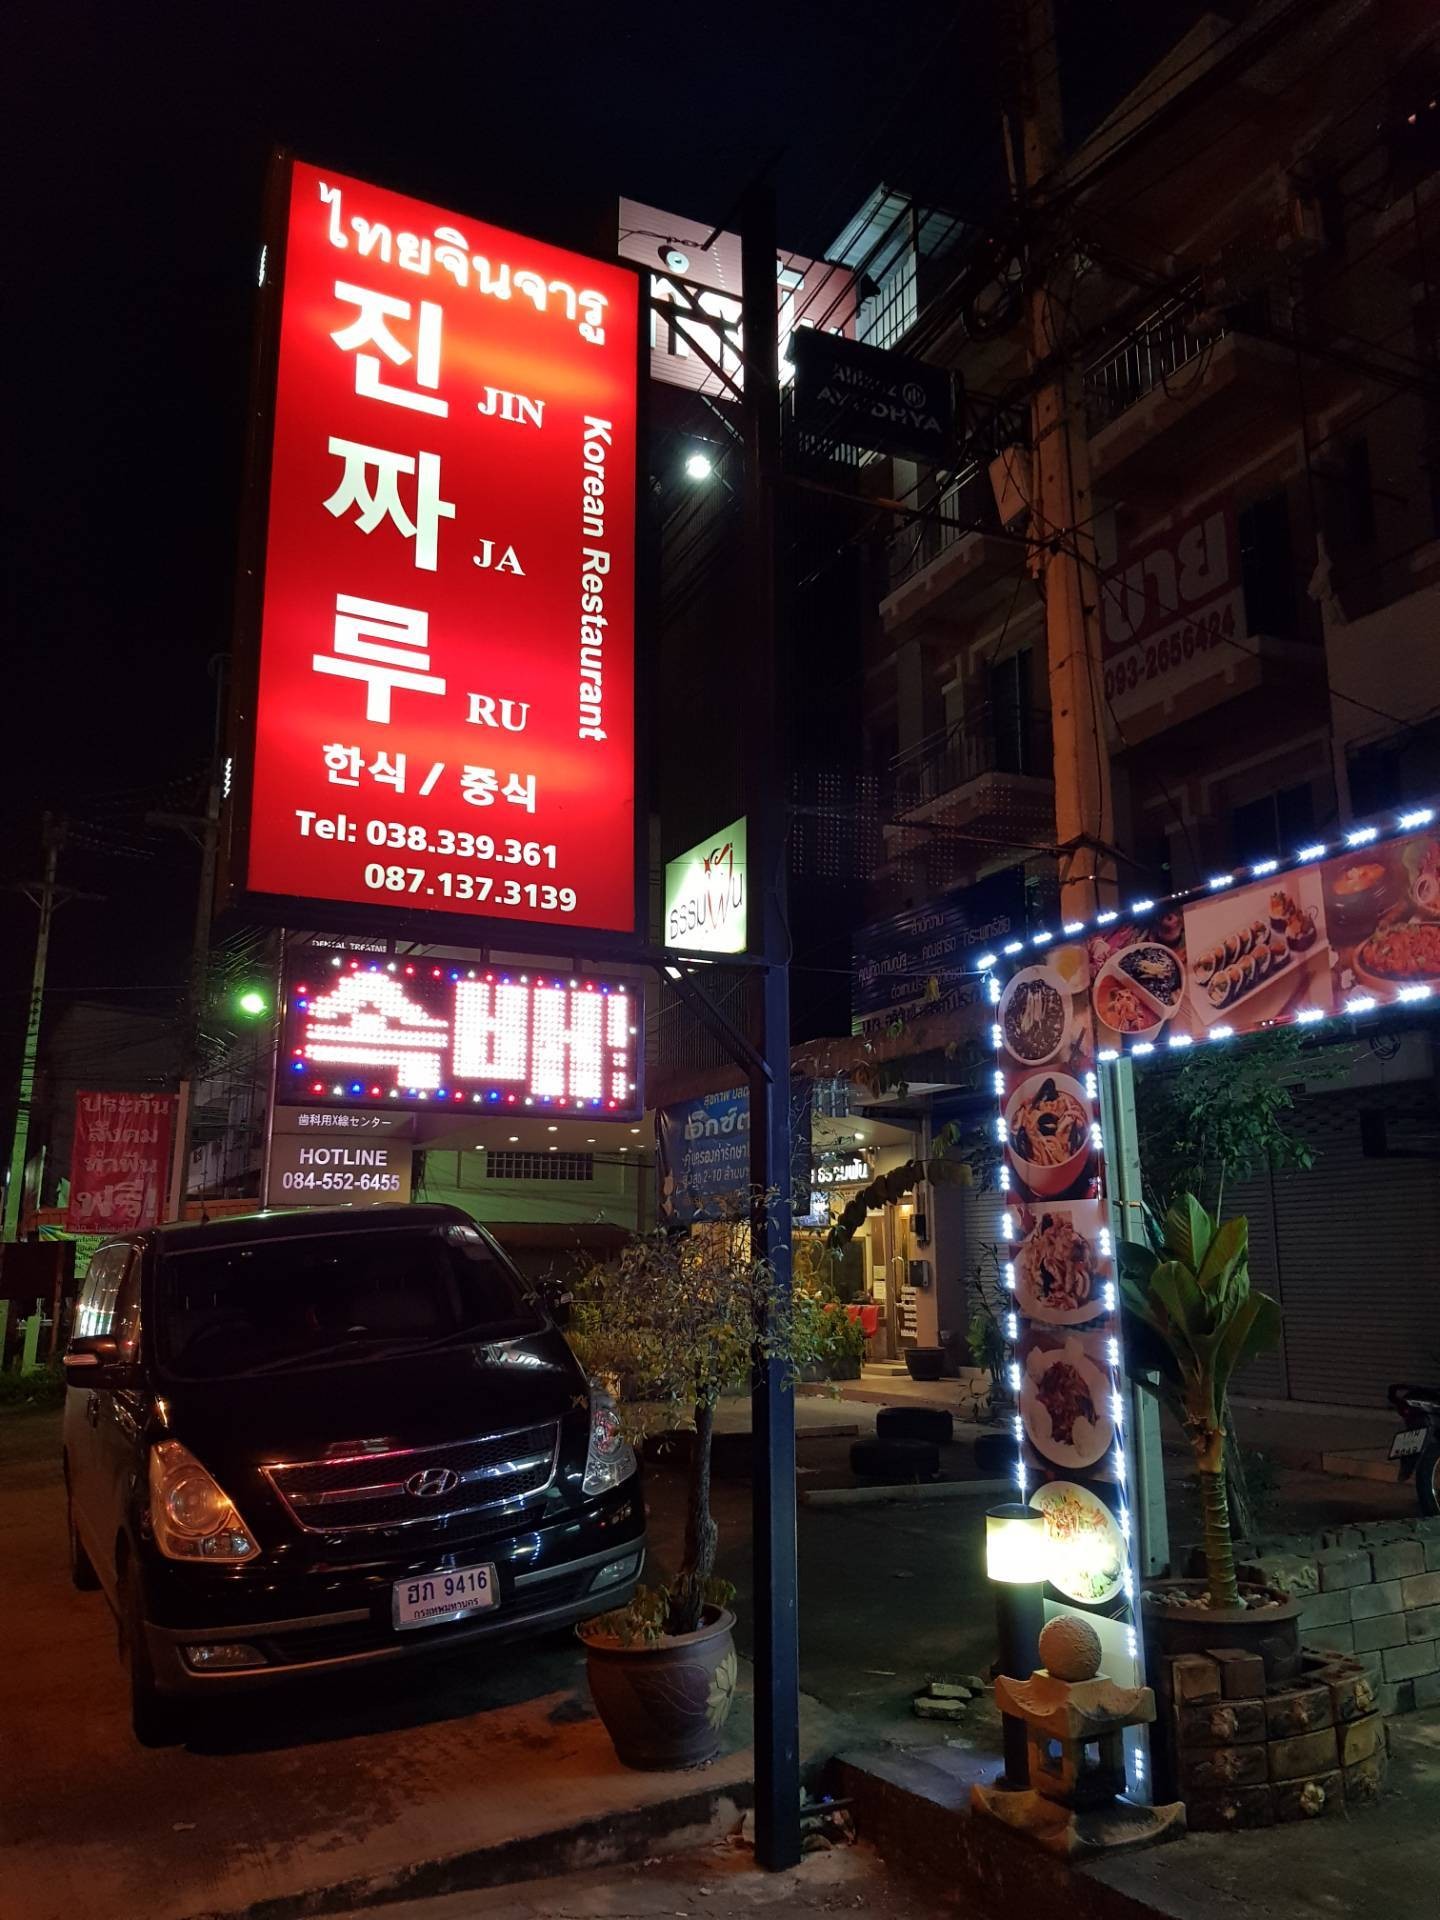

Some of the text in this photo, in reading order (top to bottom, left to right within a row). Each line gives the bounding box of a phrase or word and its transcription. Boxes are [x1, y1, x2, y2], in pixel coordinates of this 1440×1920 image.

[318, 181, 609, 346] ไทยจินจารู
[477, 386, 546, 429] JIN
[472, 538, 526, 576] JA
[578, 415, 613, 742] Korean Restaurant
[1103, 603, 1235, 702] 093-2656424
[465, 692, 531, 732] RU
[322, 743, 407, 794] 한식
[459, 765, 537, 814] 중식
[295, 809, 558, 869] Tel: 038.339.361
[364, 863, 578, 912] 087.137.3139
[81, 1093, 168, 1115] ประกัน
[297, 1112, 393, 1129] 歯科用X線センター
[88, 1121, 158, 1144] สังคม
[84, 1151, 158, 1173] ทำฟัน
[299, 1147, 388, 1167] HOTLINE
[282, 1171, 400, 1192] 084-552-6455
[444, 1570, 488, 1597] 9416
